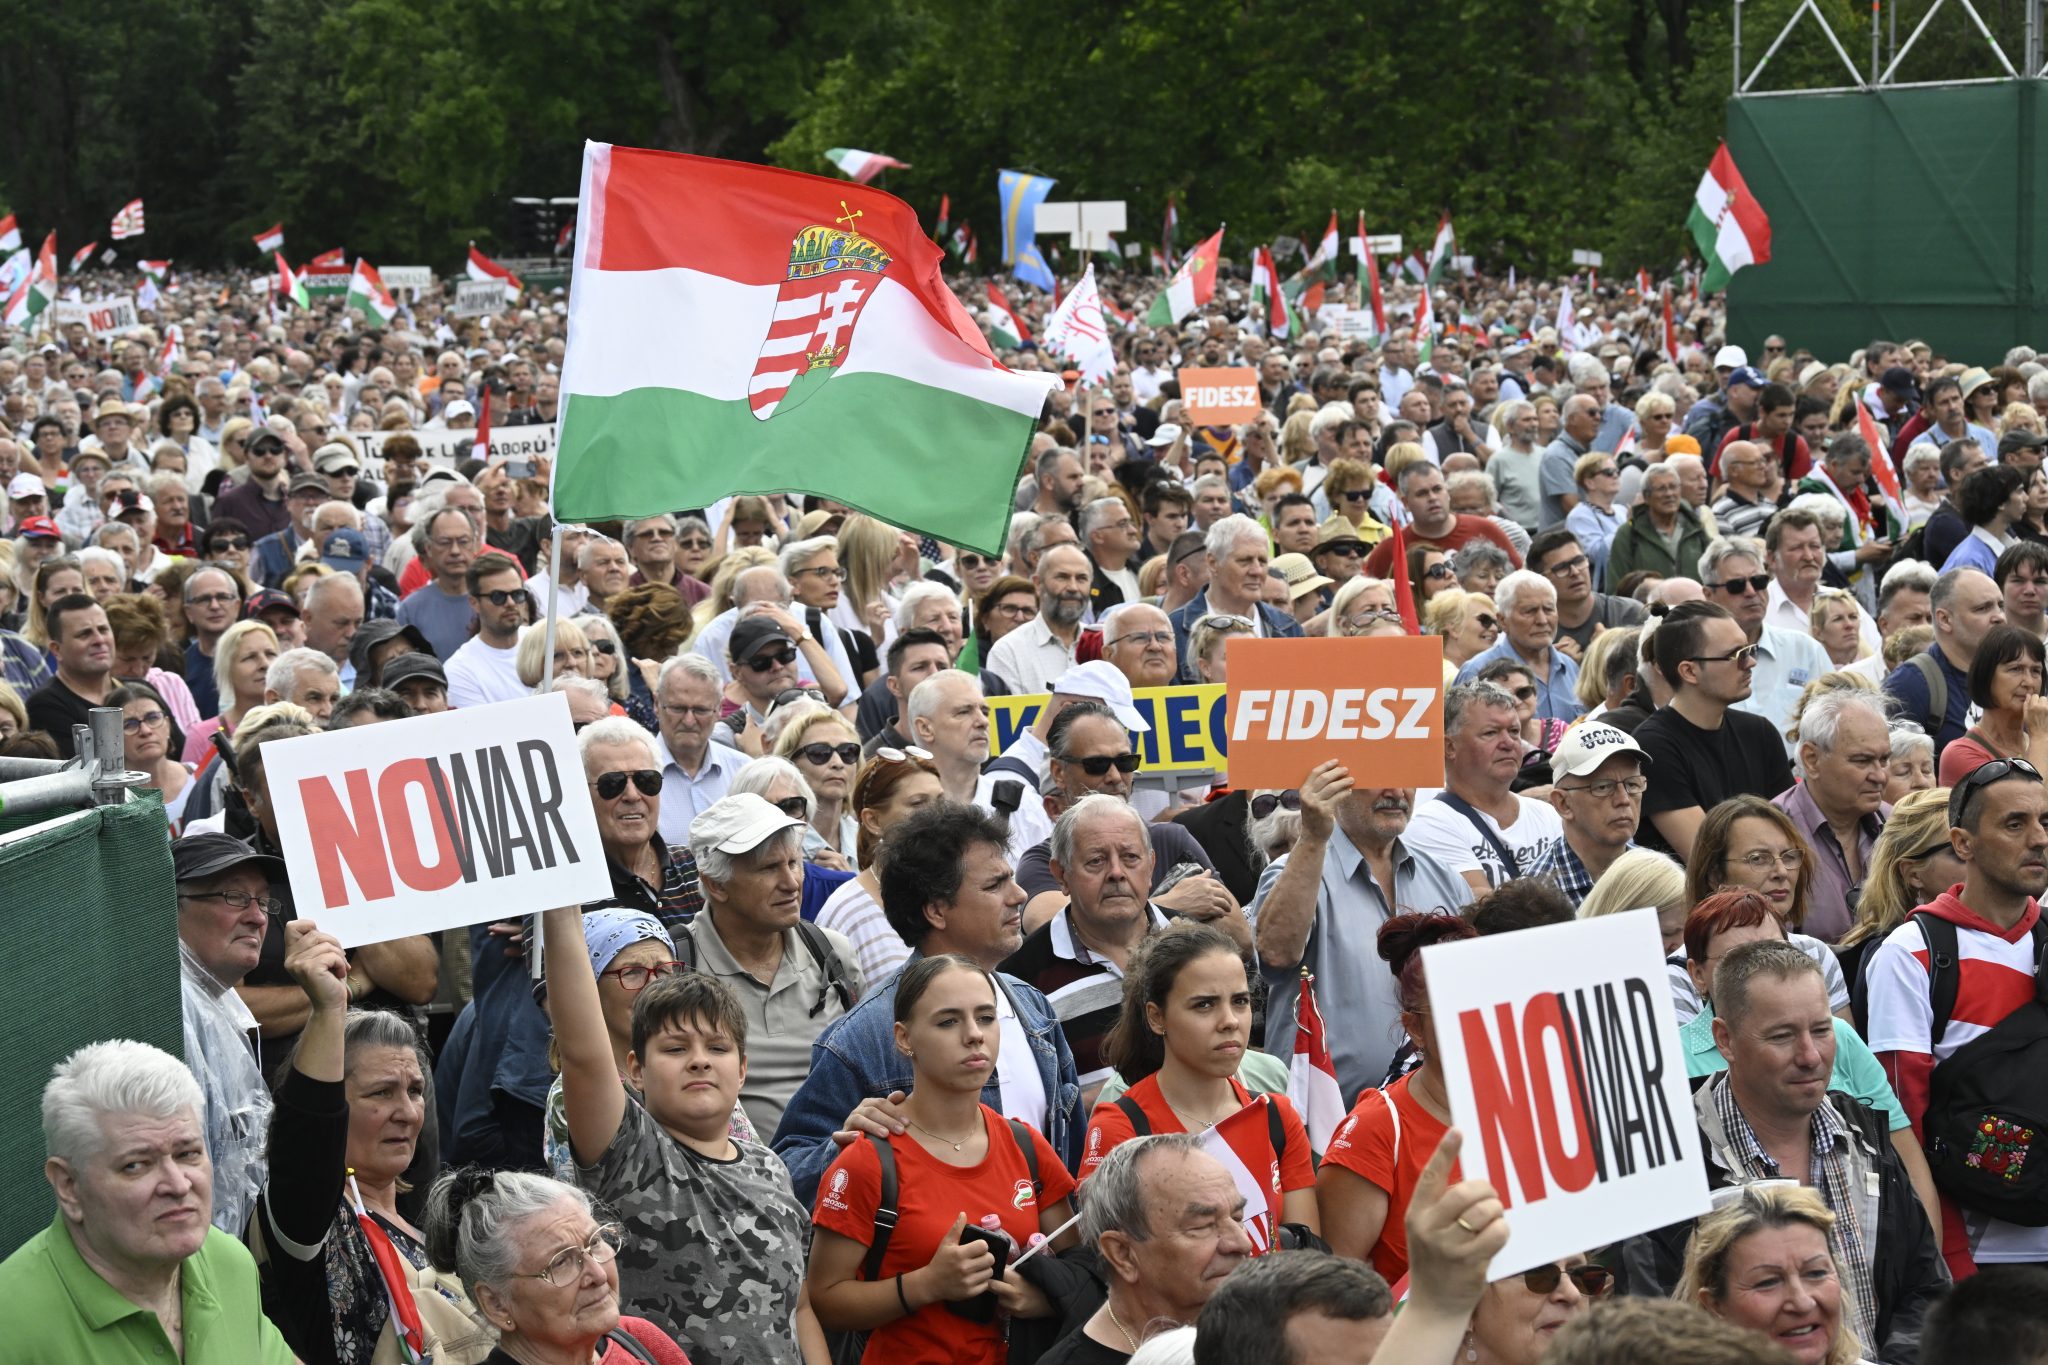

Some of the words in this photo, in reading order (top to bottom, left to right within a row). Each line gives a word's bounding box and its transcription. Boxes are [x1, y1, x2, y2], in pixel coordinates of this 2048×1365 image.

[88, 308, 116, 332] NO
[1184, 385, 1257, 409] FIDESZ
[488, 426, 556, 456] ÁBORÚ!
[1231, 687, 1437, 741] FIDESZ
[298, 757, 464, 909] NO
[425, 738, 581, 884] WAR
[1458, 991, 1598, 1211] NO
[1556, 976, 1683, 1184] WAR
